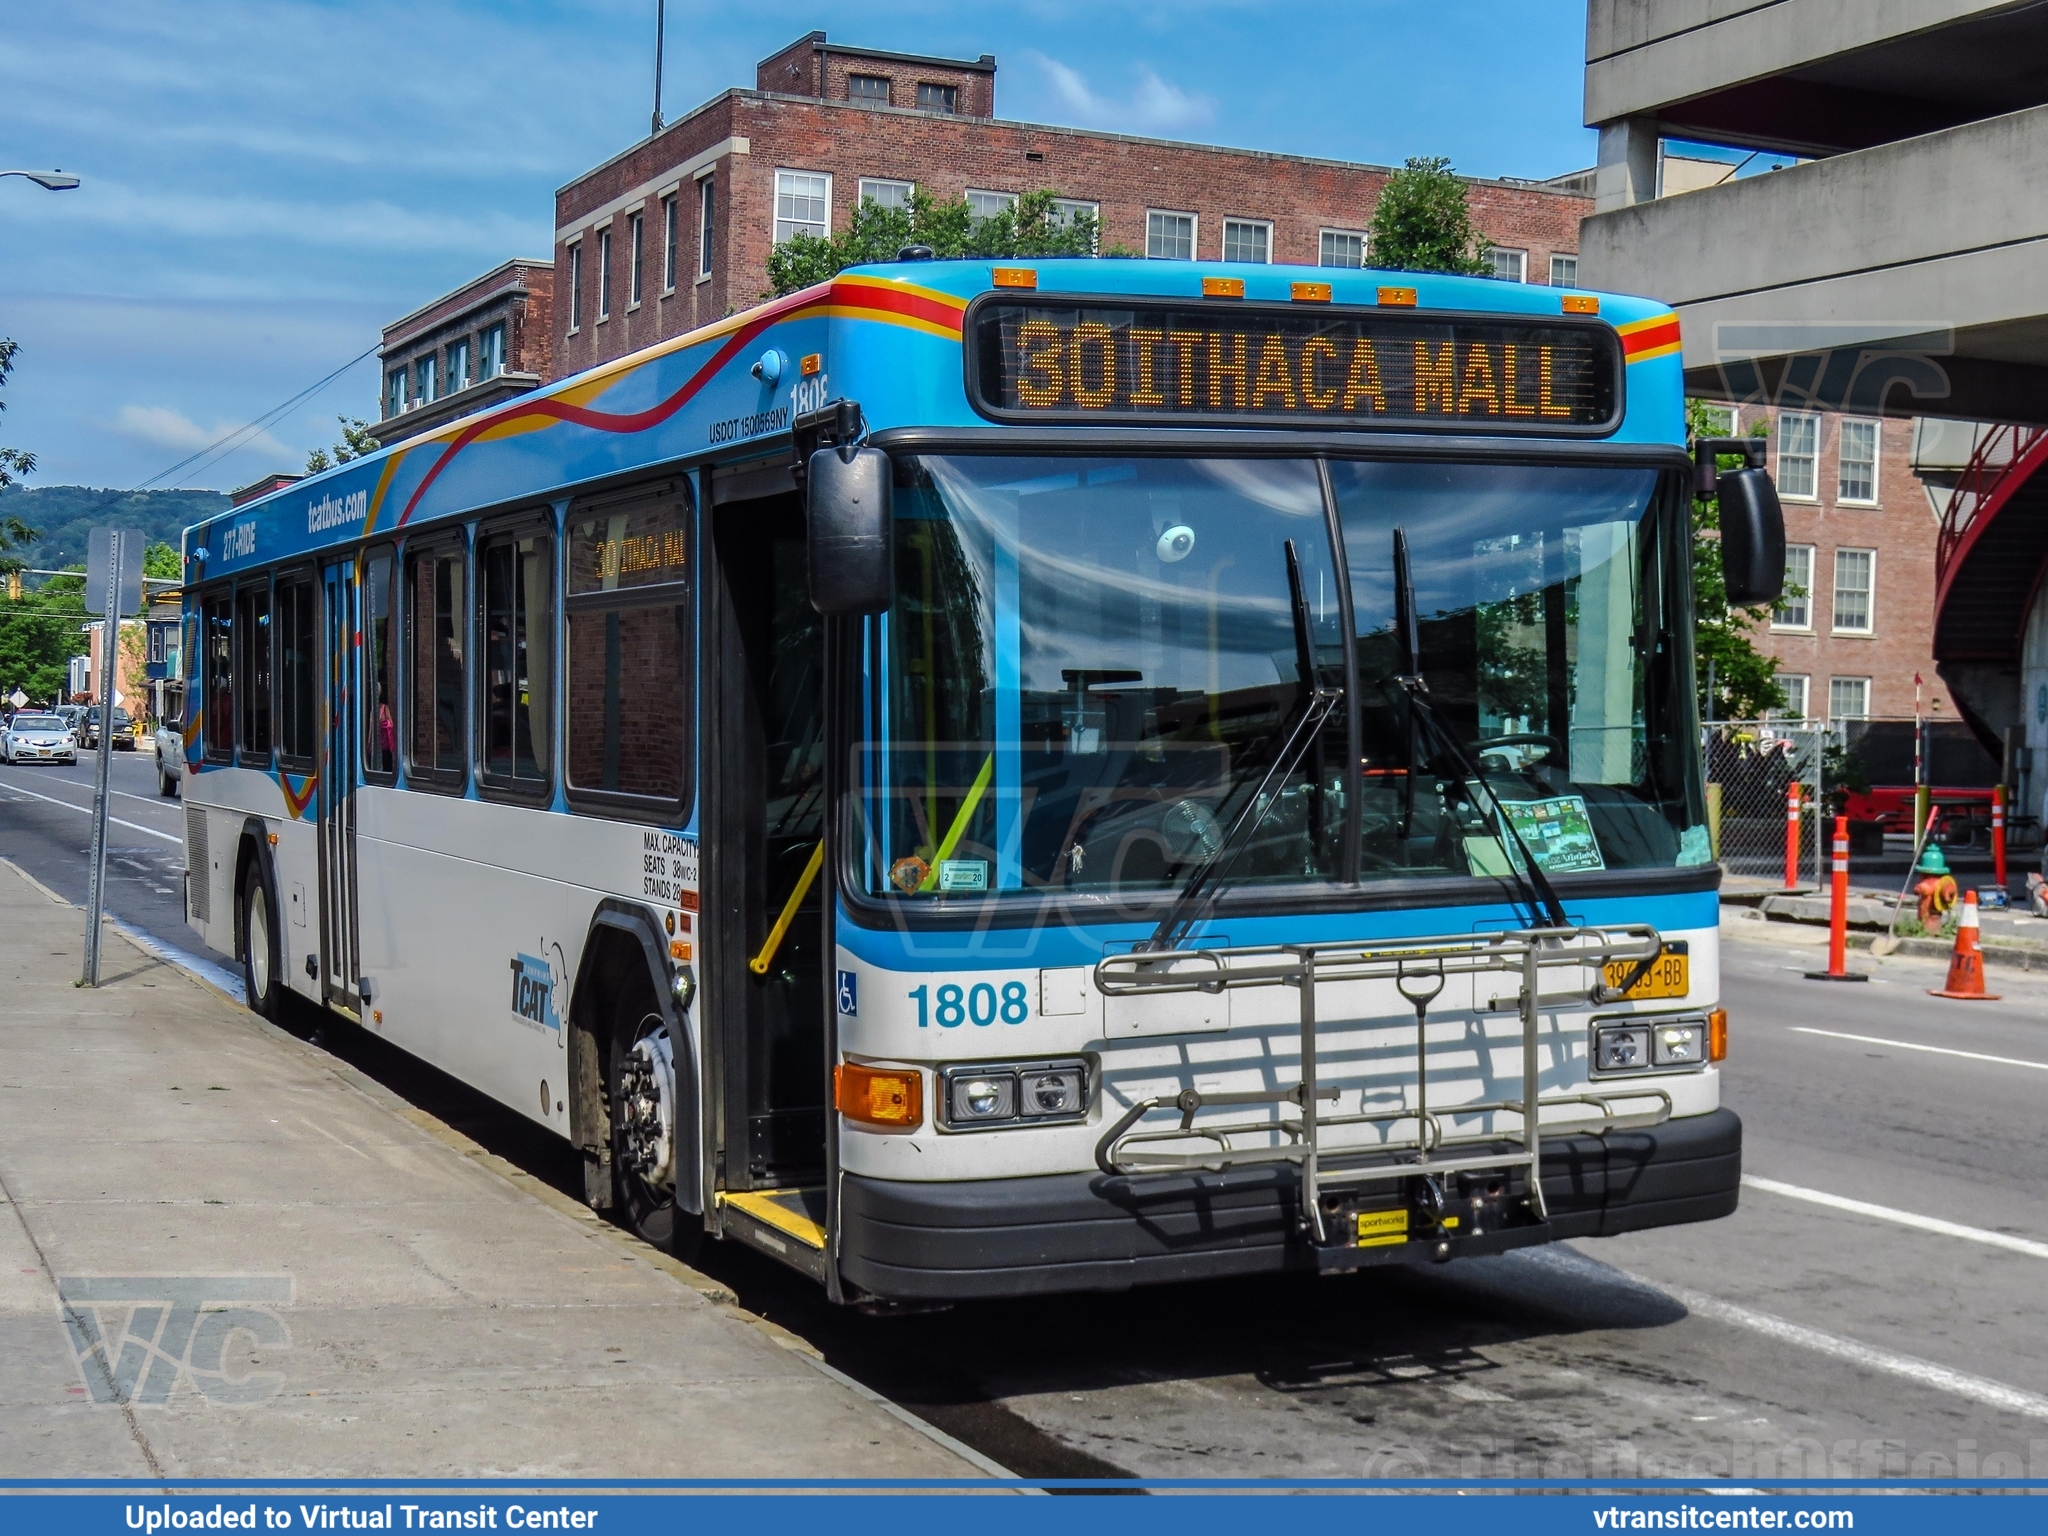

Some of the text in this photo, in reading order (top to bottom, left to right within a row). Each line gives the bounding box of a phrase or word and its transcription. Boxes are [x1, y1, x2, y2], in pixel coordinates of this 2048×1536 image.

[1016, 320, 1572, 417] 30 ITHACA MALL
[709, 406, 789, 444] USDOT 1500569NY
[308, 489, 367, 534] tcatbus.com
[223, 521, 256, 562] 277-RIDE
[595, 540, 616, 578] 30
[643, 831, 662, 852] MAX.
[643, 853, 666, 876] SEATS
[672, 859, 681, 880] 38
[944, 873, 949, 882] 2
[972, 873, 982, 882] 20
[643, 876, 681, 902] STANDS 28
[510, 958, 548, 1025] TCAT
[908, 980, 1028, 1028] 1808
